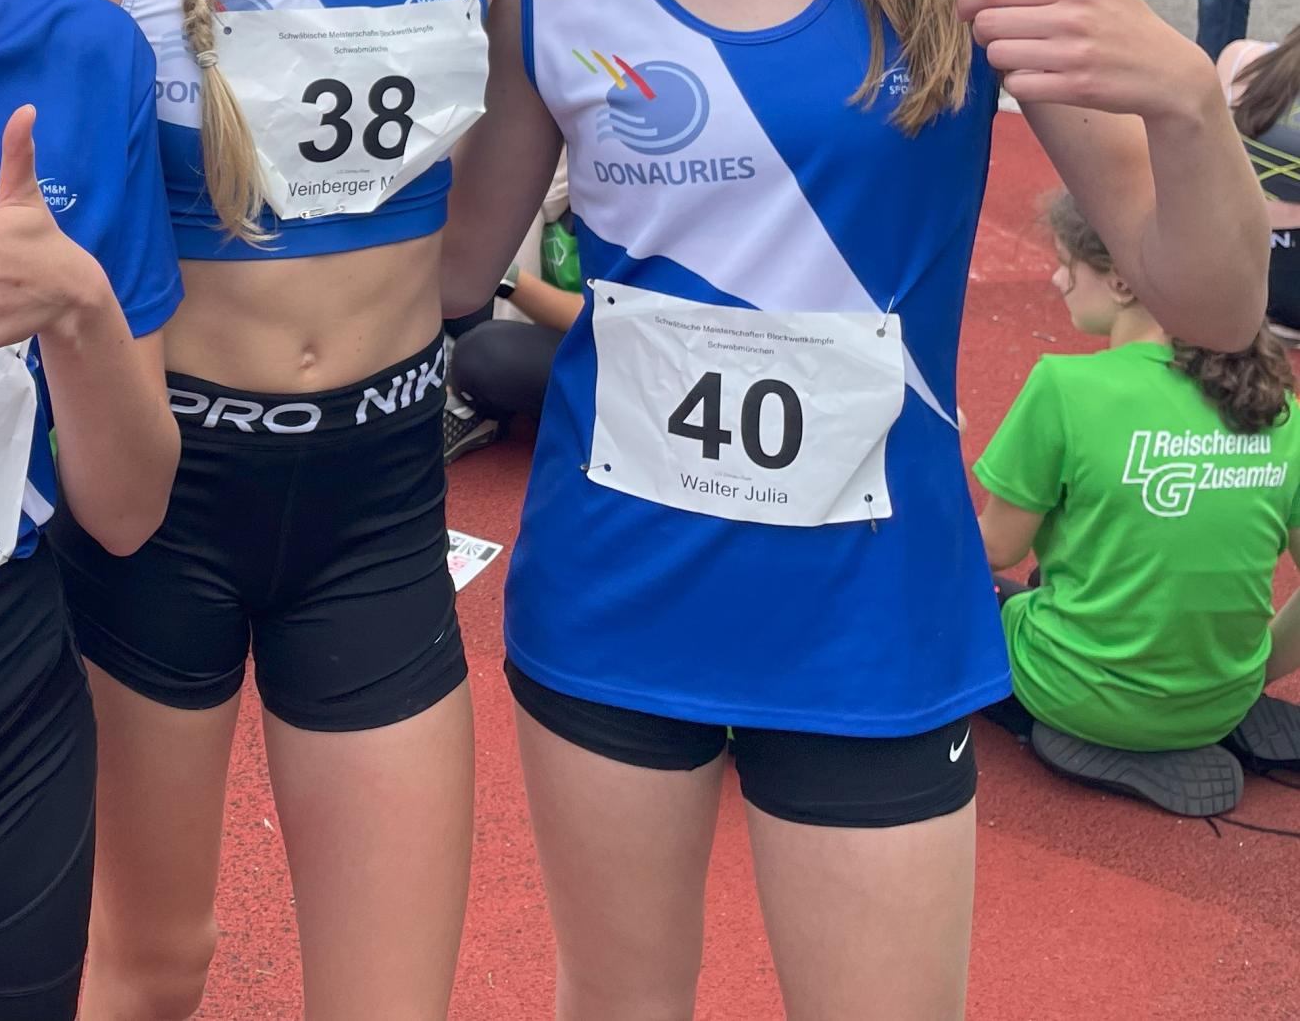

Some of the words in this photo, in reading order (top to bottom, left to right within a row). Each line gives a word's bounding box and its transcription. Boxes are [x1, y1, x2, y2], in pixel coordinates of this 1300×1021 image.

[298, 74, 416, 163] 38
[380, 175, 395, 191] M
[593, 155, 756, 186] DONAURIES
[43, 184, 66, 194] M&M
[654, 316, 702, 332] Schwäbische
[703, 325, 765, 339] Meisterschaften
[766, 332, 835, 346] Blockwettkämpfe
[707, 340, 775, 355] Schwabmünchen
[167, 387, 322, 435] PRO
[355, 347, 446, 425] NIK
[667, 371, 803, 469] 40
[1153, 428, 1272, 458] Reischenau
[680, 472, 740, 498] Walter
[744, 486, 788, 504] Julia
[1198, 461, 1289, 490] Zusamtal
